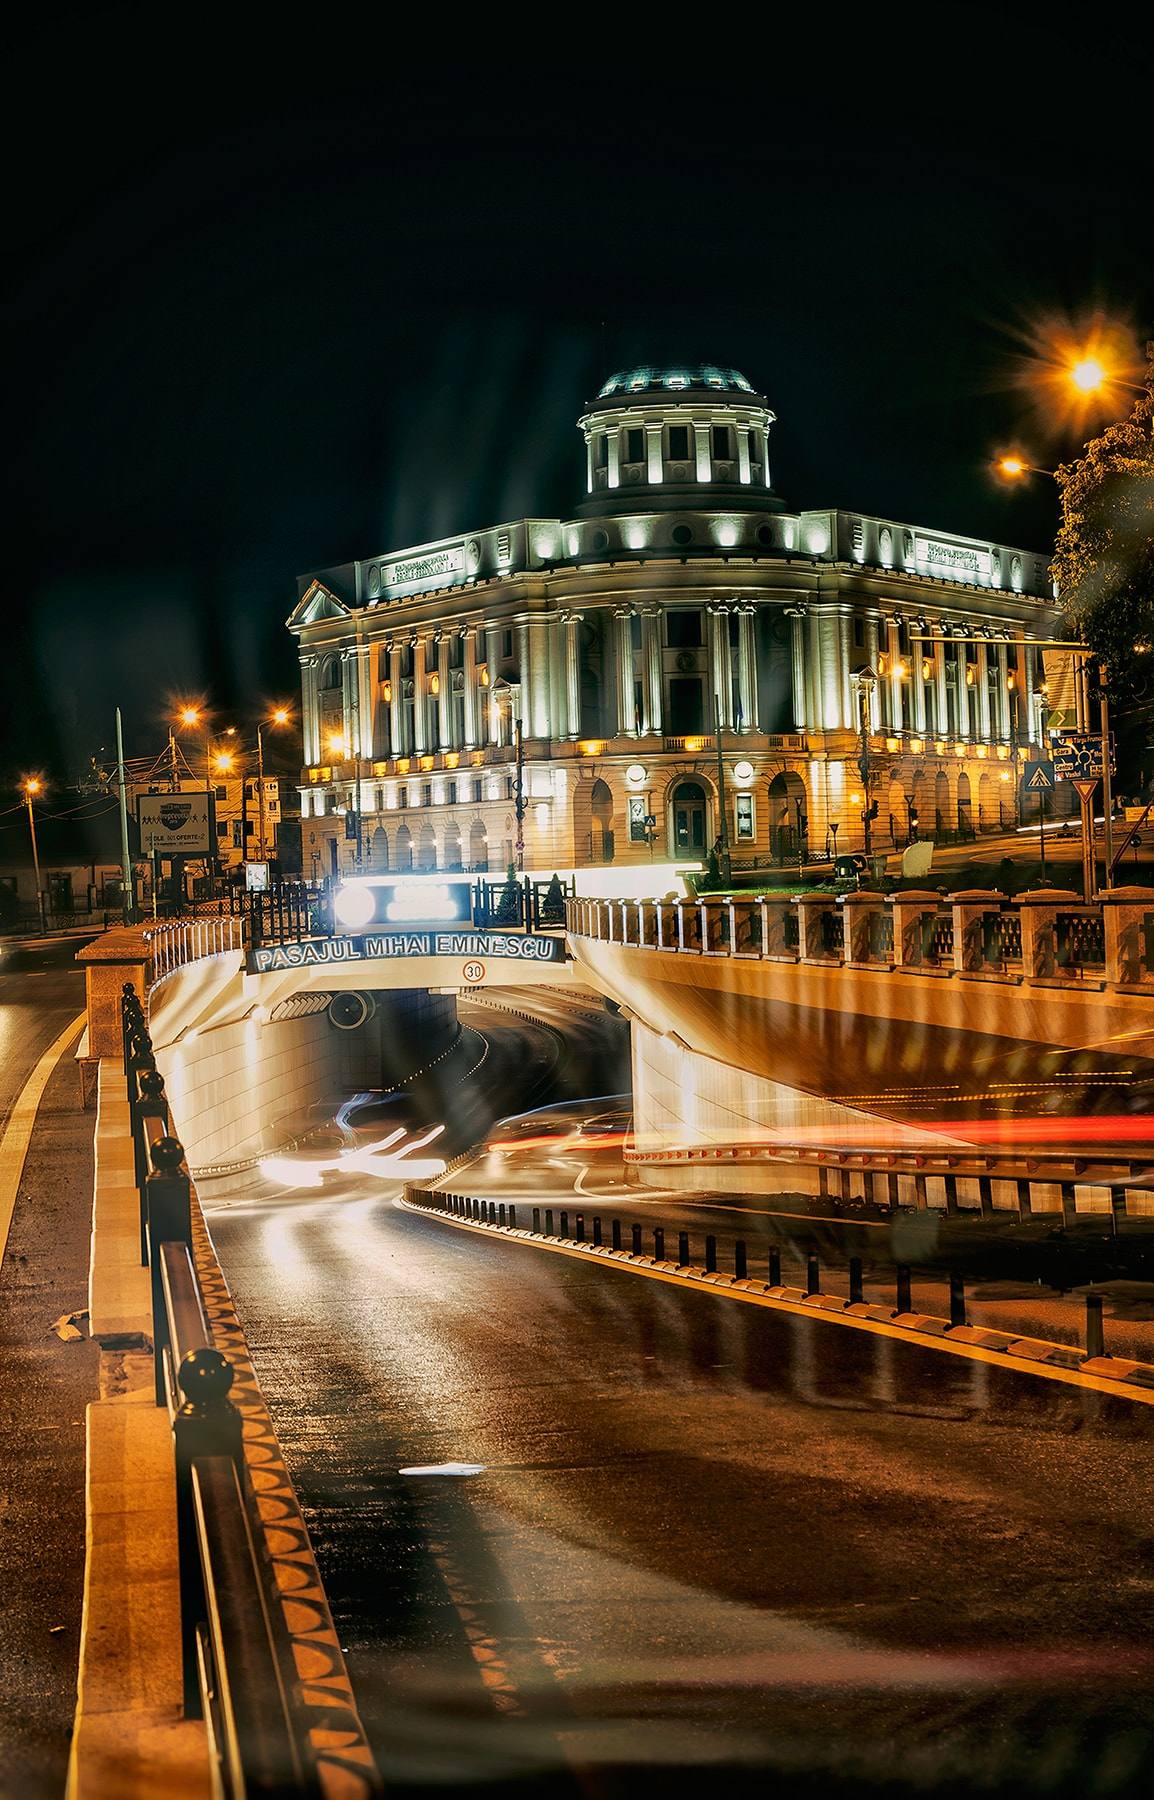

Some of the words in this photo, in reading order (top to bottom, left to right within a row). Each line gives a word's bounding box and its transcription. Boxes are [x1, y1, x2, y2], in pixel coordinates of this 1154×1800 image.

[256, 940, 360, 971] PASAJUL
[366, 934, 430, 956] MIHAI
[436, 934, 553, 959] EMINESCU
[467, 966, 481, 978] 30
